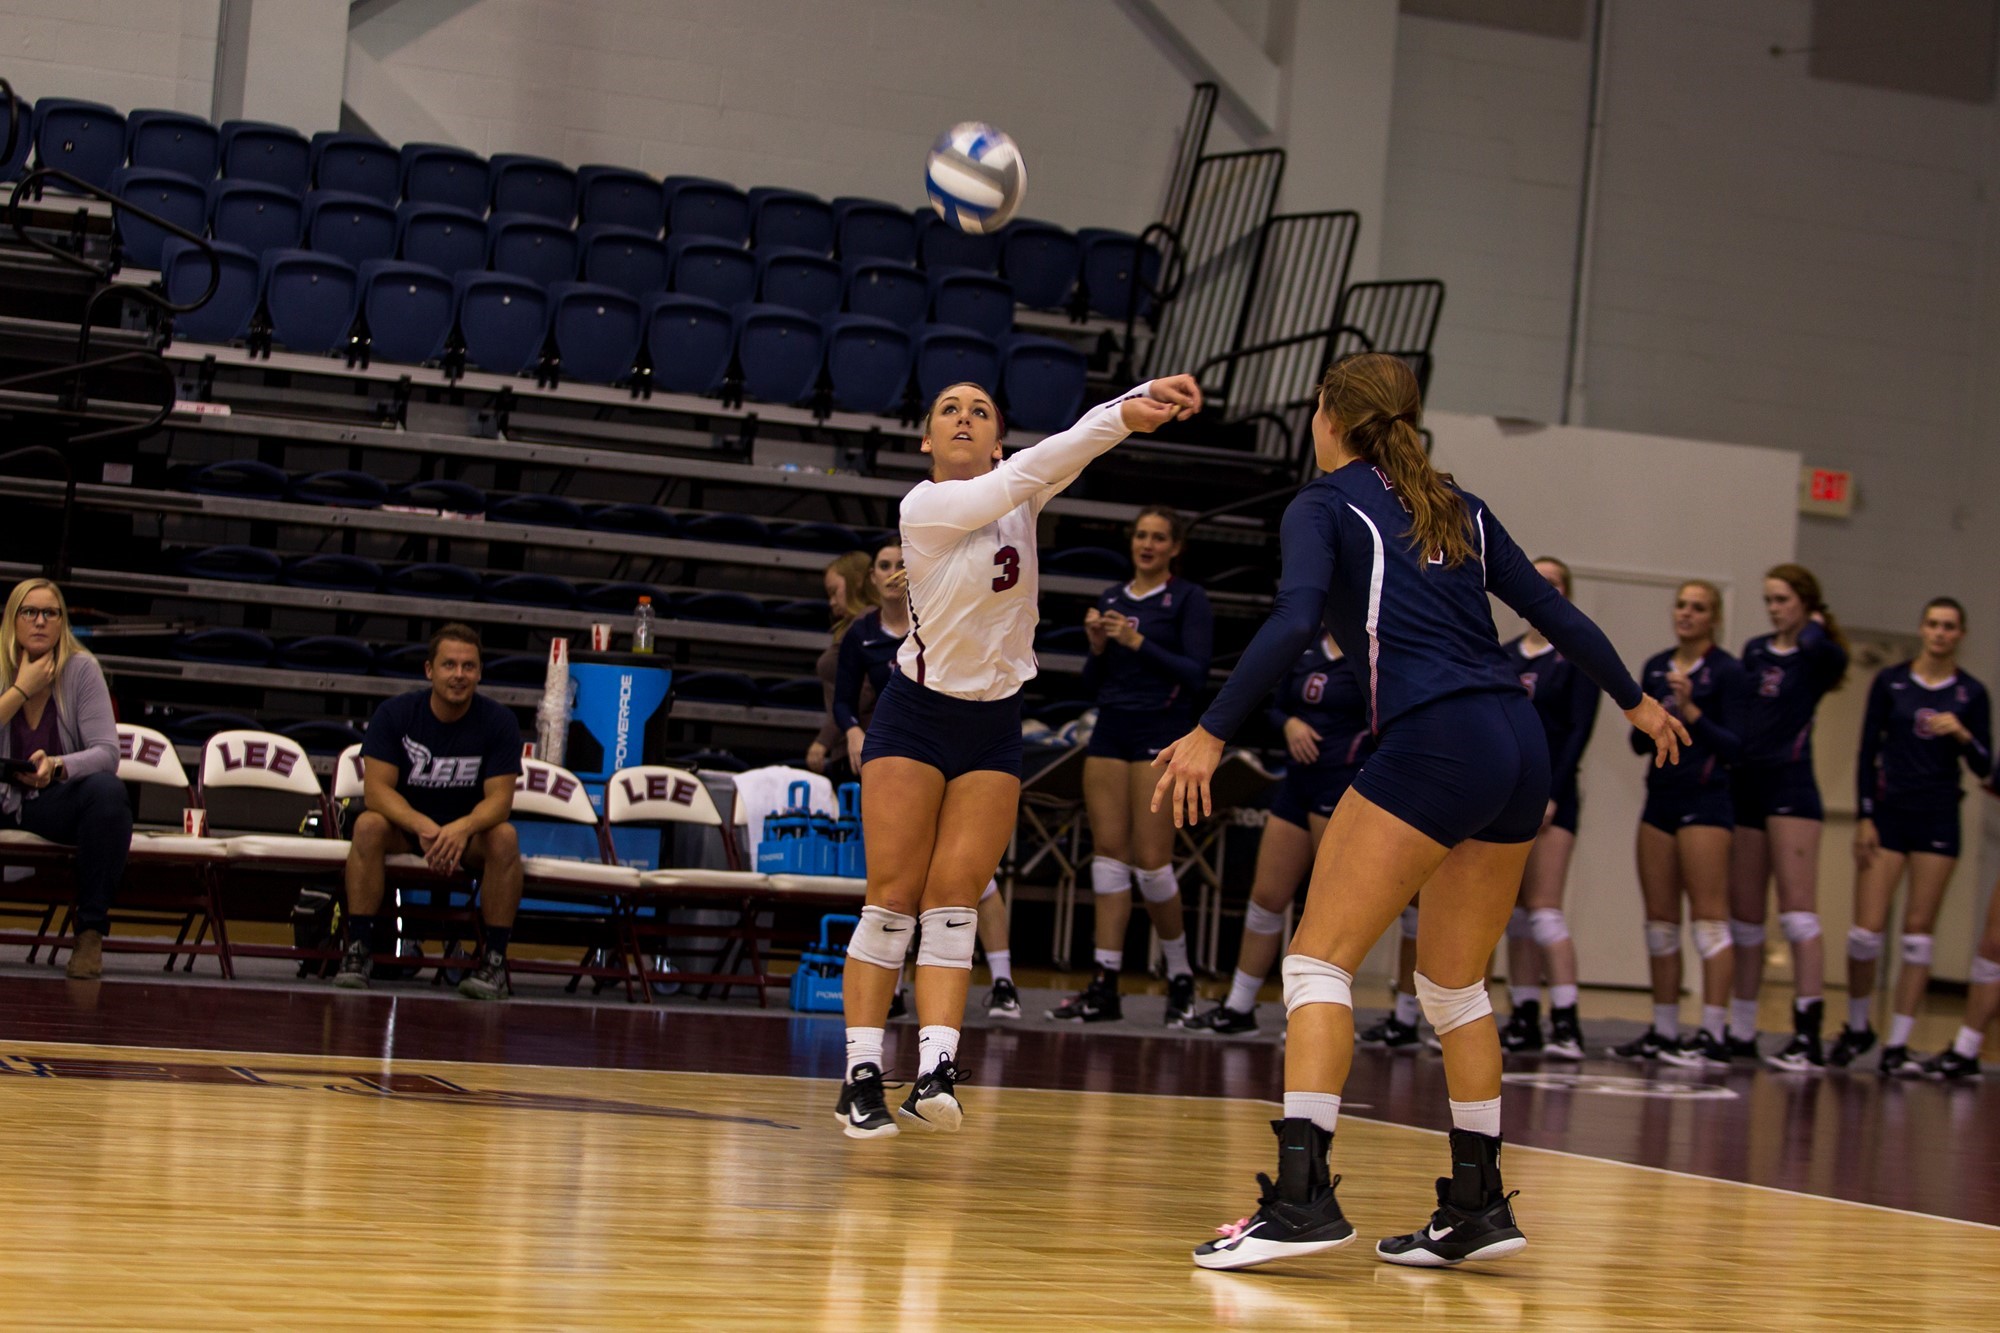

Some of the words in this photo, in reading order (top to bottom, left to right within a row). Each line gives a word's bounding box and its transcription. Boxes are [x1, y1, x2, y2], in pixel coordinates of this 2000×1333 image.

[1811, 469, 1849, 501] EXIT
[992, 545, 1020, 593] 3
[1302, 672, 1328, 704] 6
[614, 674, 632, 771] POWERADE
[118, 733, 167, 767] EE
[216, 740, 300, 778] LEE
[407, 778, 476, 788] VOLLEYBALL
[408, 753, 482, 782] LEE
[619, 774, 698, 806] LEE
